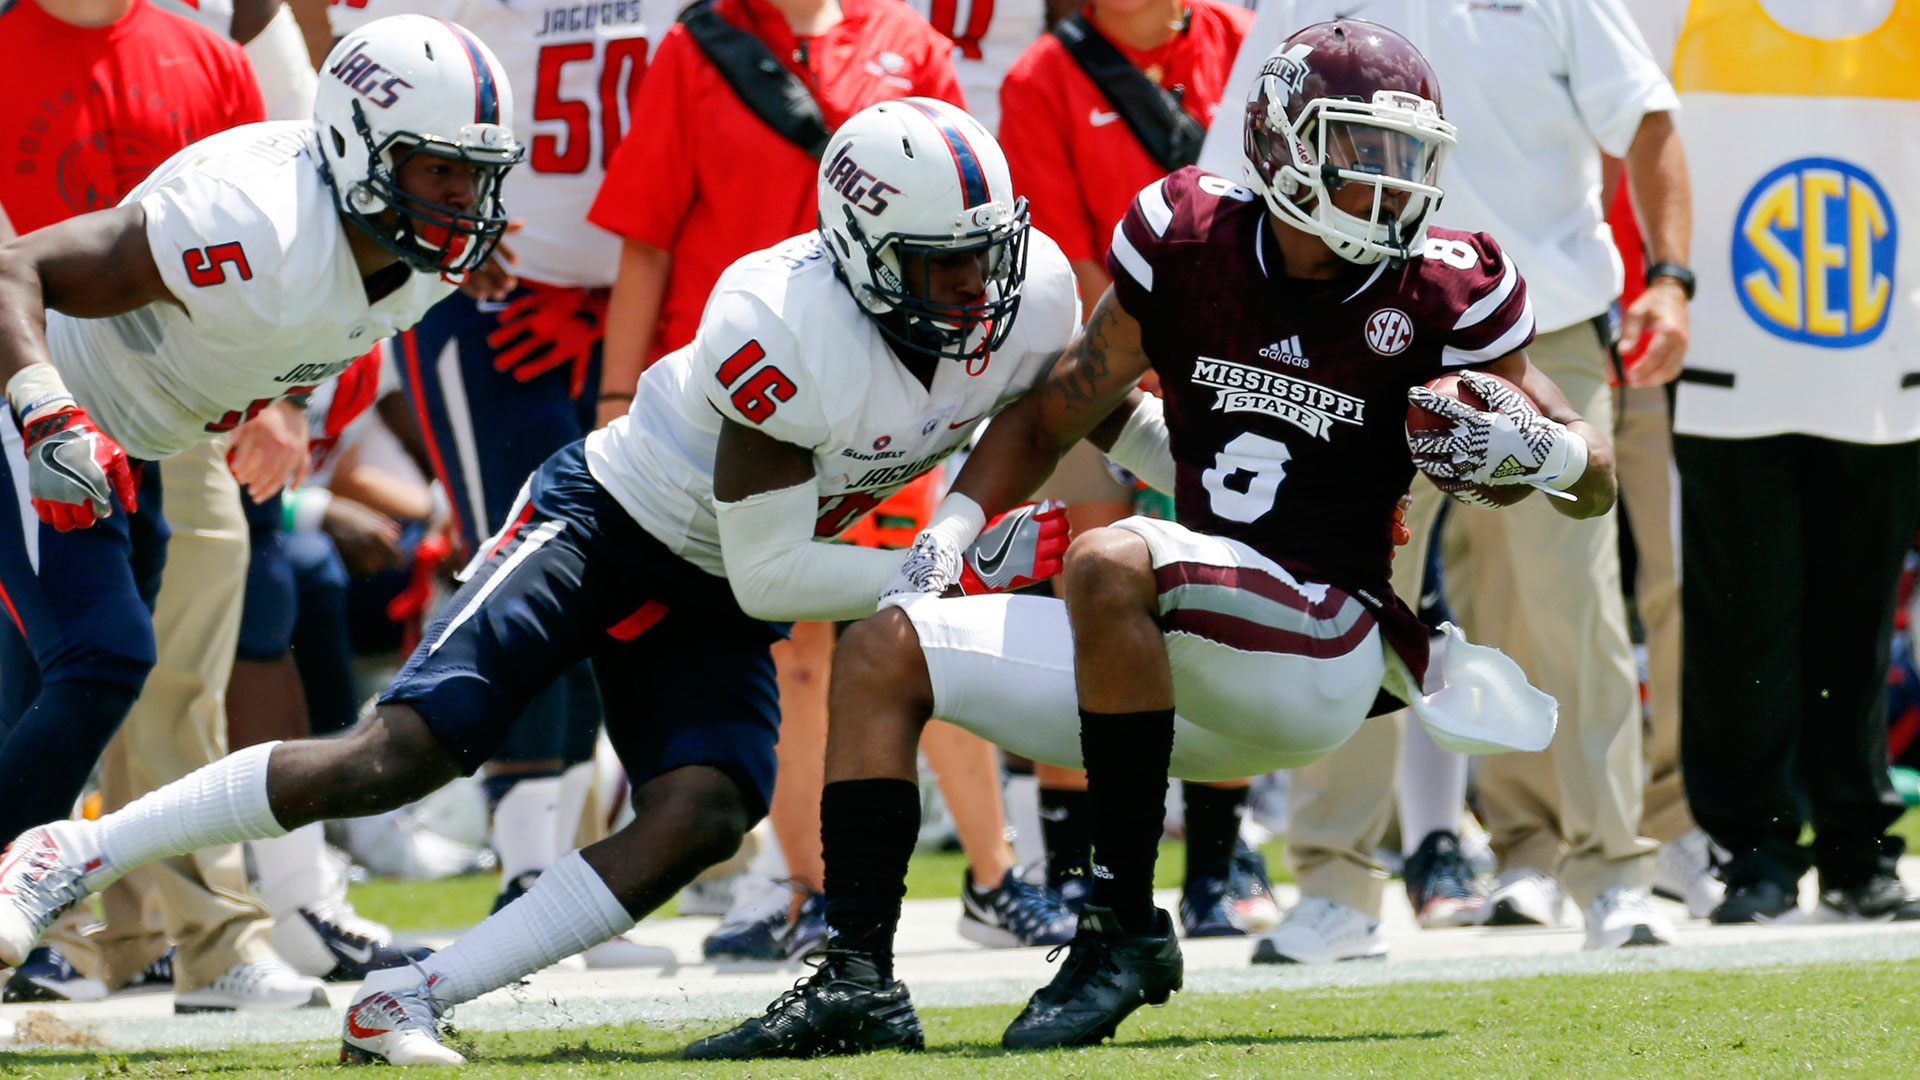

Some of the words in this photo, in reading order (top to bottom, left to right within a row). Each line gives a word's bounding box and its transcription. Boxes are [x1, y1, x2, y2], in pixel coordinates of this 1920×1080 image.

[535, 0, 642, 37] JAGUARS
[330, 40, 416, 110] JAGS
[530, 36, 650, 175] 50
[824, 140, 902, 217] JAGS
[182, 240, 253, 288] 5
[1423, 236, 1480, 271] 8
[1742, 167, 1892, 338] SEC
[1258, 347, 1311, 370] adidas
[1368, 310, 1411, 353] SEC
[715, 338, 798, 425] 16
[1191, 360, 1366, 422] MISSISSIPPI
[1232, 395, 1312, 429] STATE
